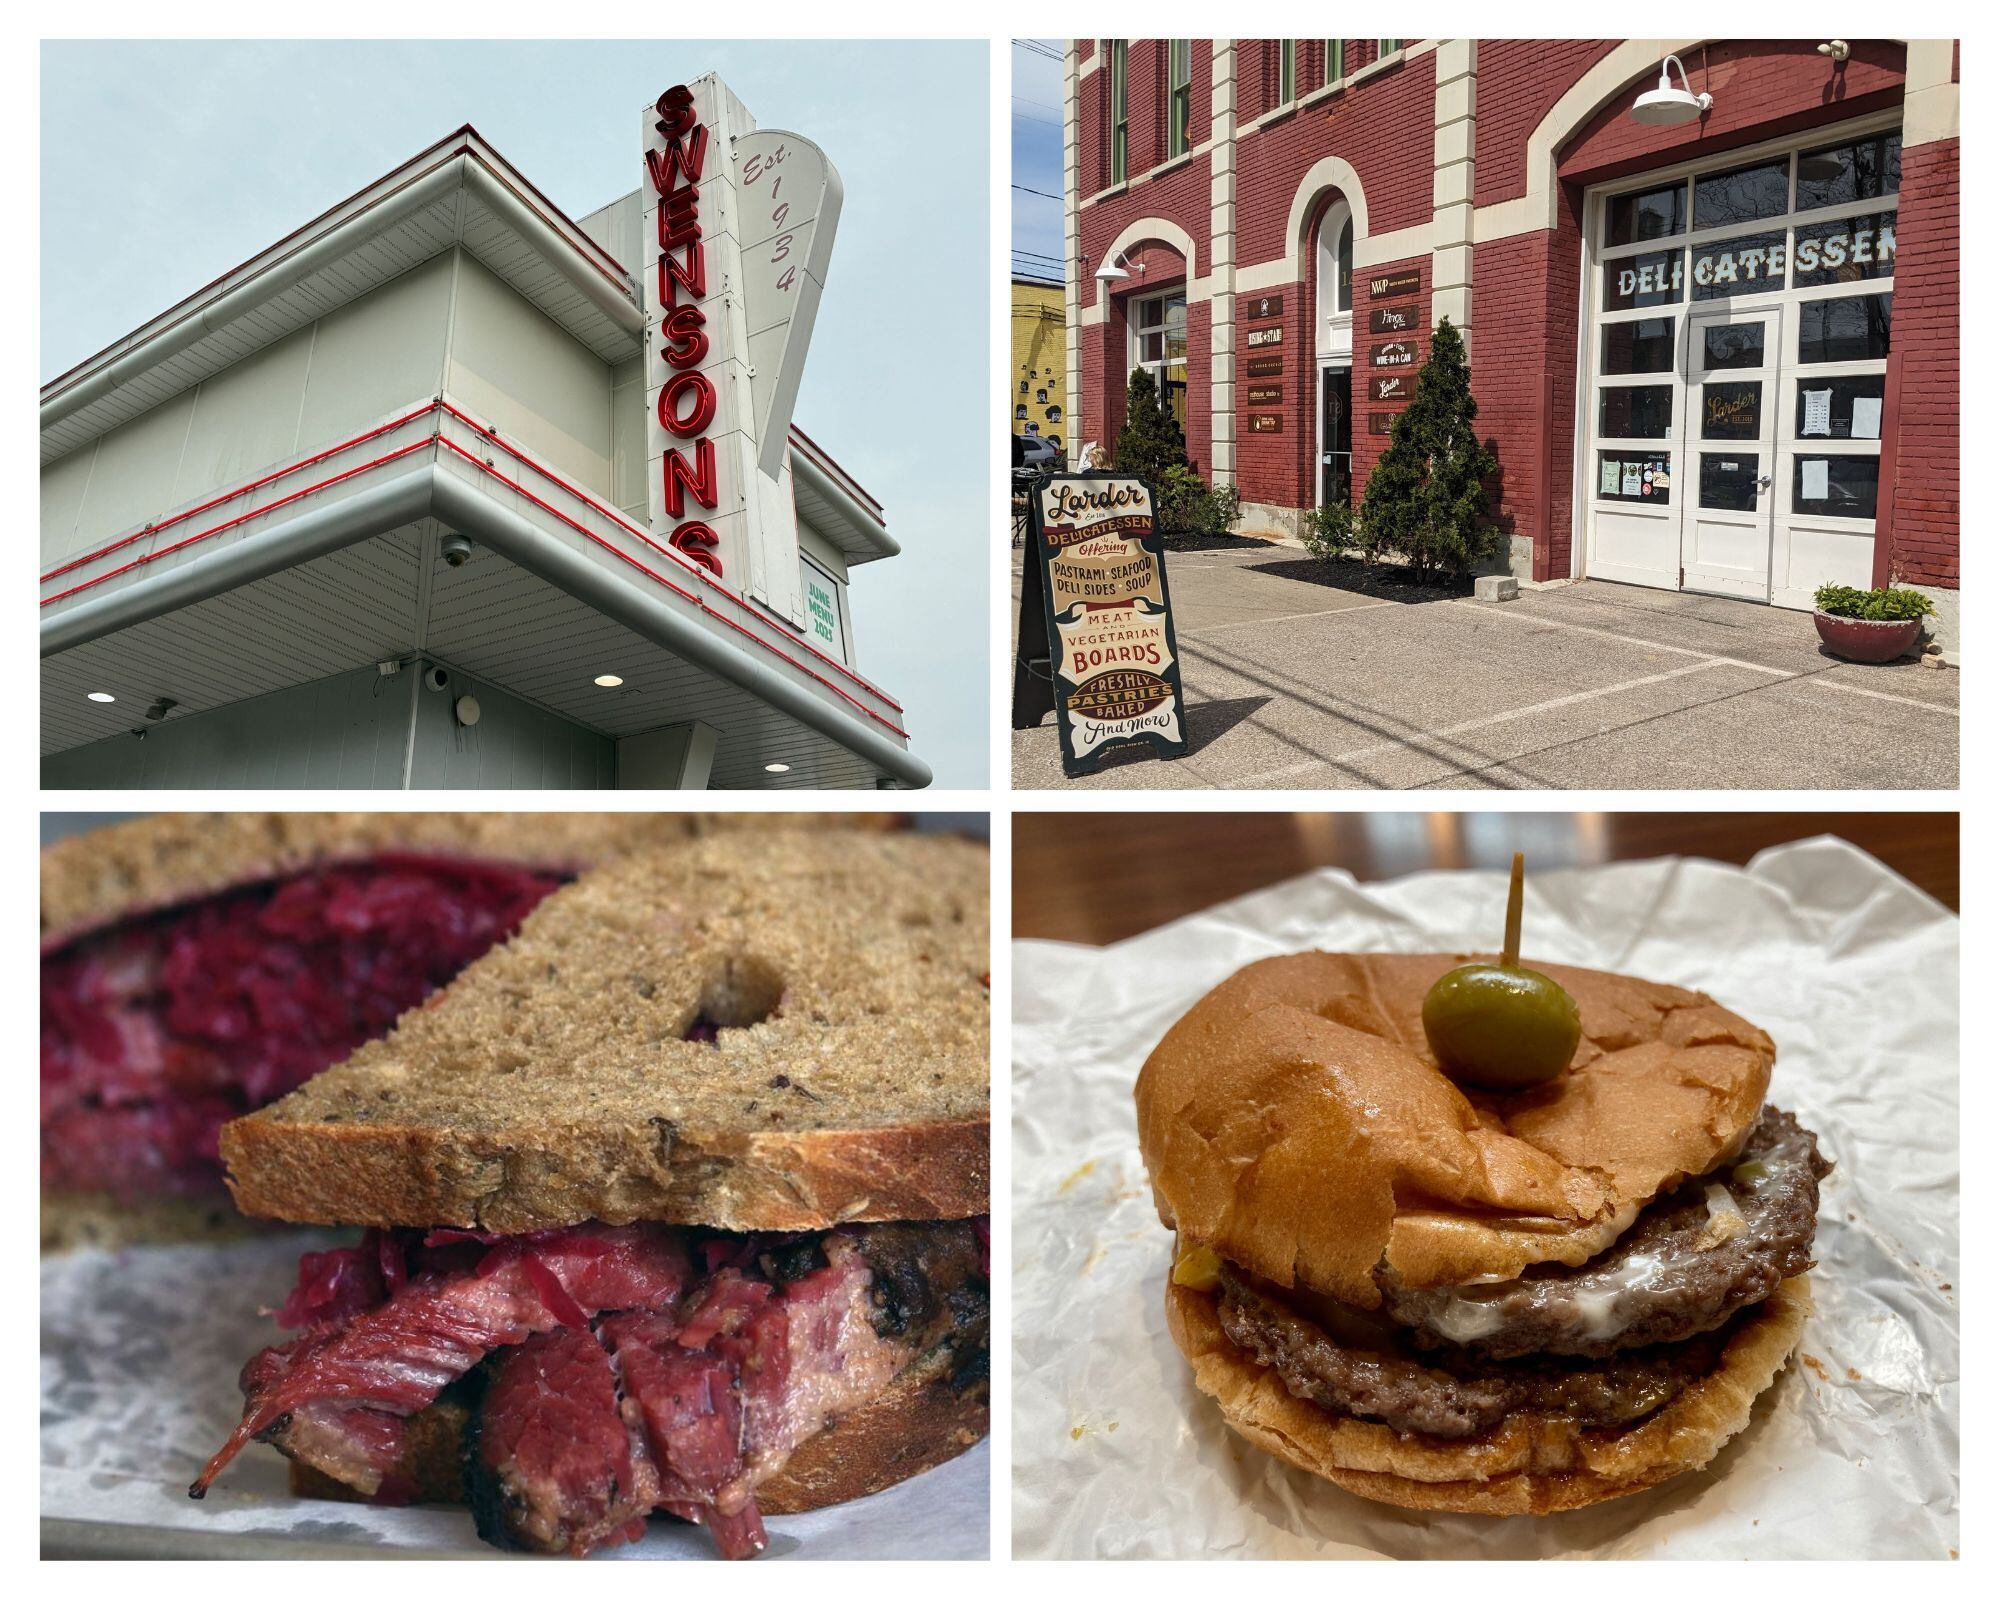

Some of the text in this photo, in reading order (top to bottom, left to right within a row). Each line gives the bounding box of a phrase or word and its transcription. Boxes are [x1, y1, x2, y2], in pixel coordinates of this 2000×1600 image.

[743, 143, 791, 186] Est.
[1371, 279, 1389, 295] NWP
[645, 84, 723, 579] SWENSONS
[1400, 352, 1411, 363] CAN
[1706, 392, 1758, 428] Larder
[1048, 482, 1145, 521] Larder
[1047, 517, 1152, 546] DELICATESSEN
[1079, 541, 1128, 557] Offering
[1054, 556, 1152, 581] PASTRAMI SEAFOOD
[809, 581, 831, 609] JUNE
[1056, 572, 1152, 596] DELI SIDES SOUP
[808, 597, 835, 628] MENU
[1088, 611, 1133, 625] MEAT
[814, 617, 833, 643] 2025
[1068, 628, 1160, 647] VEGETARIAN
[1072, 642, 1161, 675] BOARDS
[1090, 673, 1151, 693] FRESHLY
[1067, 685, 1173, 709] PASTRIES
[1096, 701, 1146, 719] BAKED
[1083, 712, 1171, 745] And More
